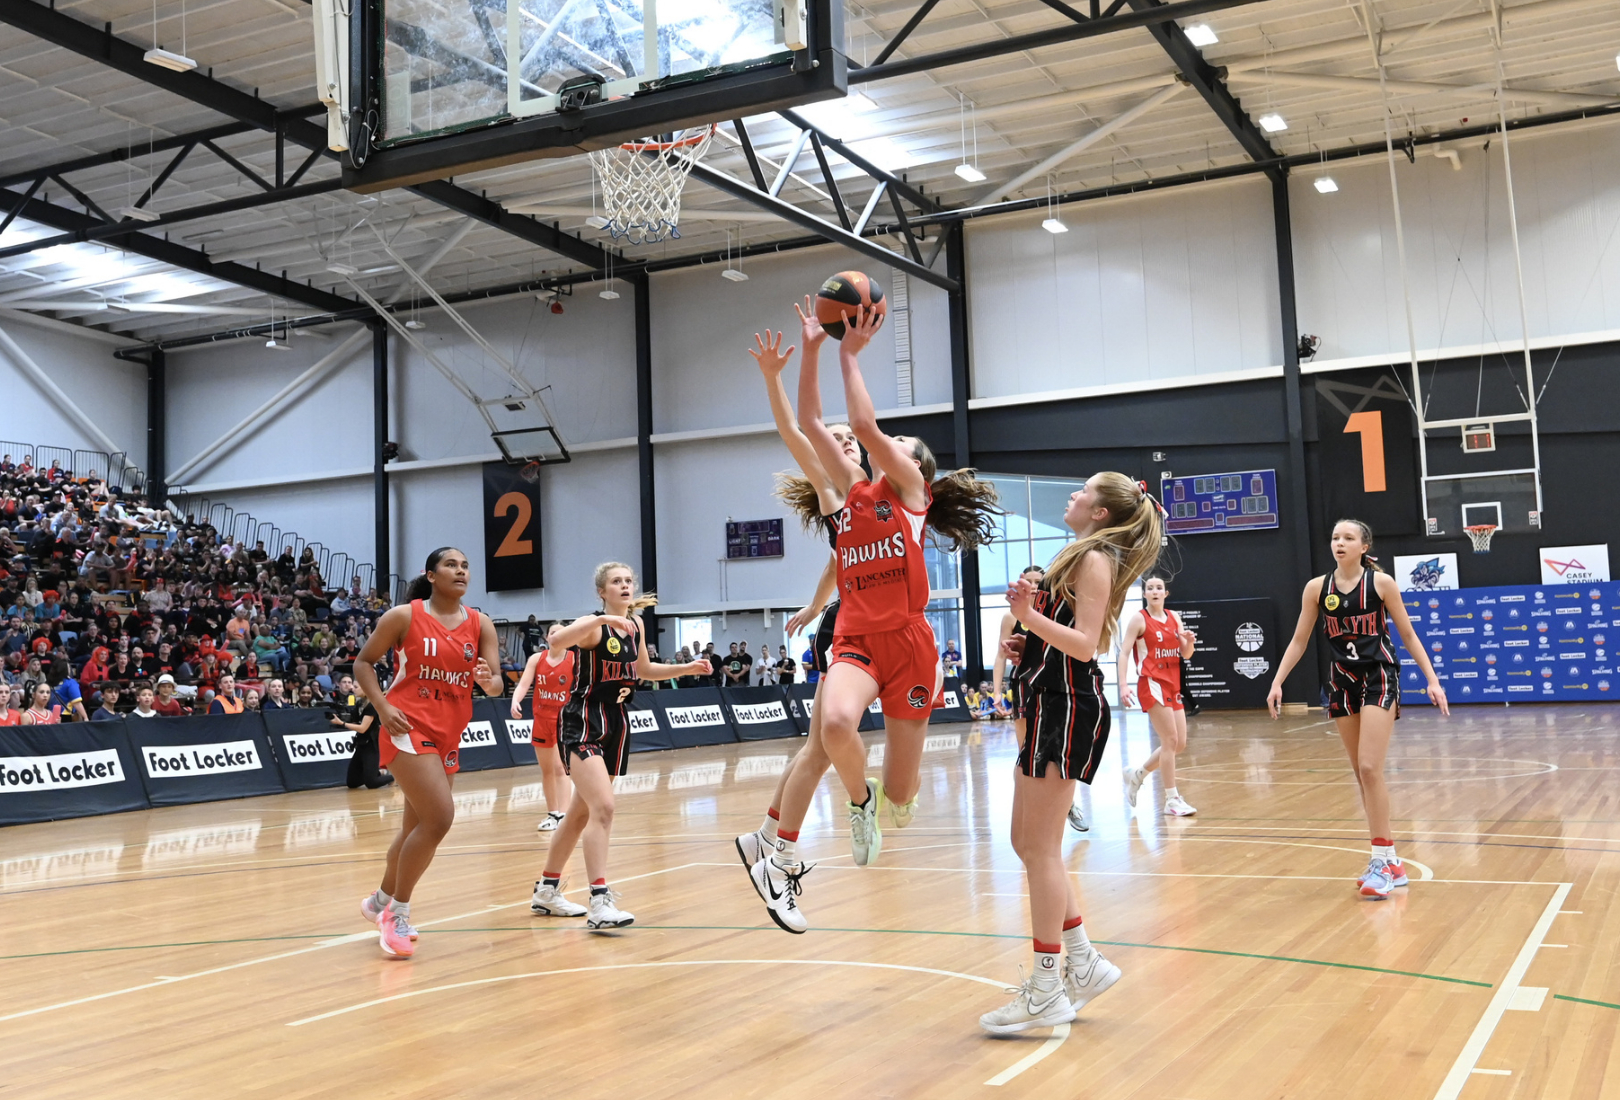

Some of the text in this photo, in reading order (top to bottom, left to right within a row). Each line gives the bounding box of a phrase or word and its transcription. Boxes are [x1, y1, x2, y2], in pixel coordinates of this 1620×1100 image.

[1343, 410, 1386, 492] 1
[493, 491, 533, 558] 2
[840, 531, 906, 571] HAWKS
[422, 636, 438, 657] 11
[1155, 630, 1164, 643] 9
[1346, 641, 1360, 660] 3
[418, 663, 471, 689] HAWKS
[601, 659, 638, 683] KILSY
[630, 714, 654, 729] cker
[669, 709, 721, 725] Foot Locker
[735, 706, 783, 721] Foot Locker
[461, 727, 490, 743] cker
[289, 737, 356, 758] Foot Loc
[46, 758, 115, 783] Locker
[148, 748, 253, 772] Foot Locker
